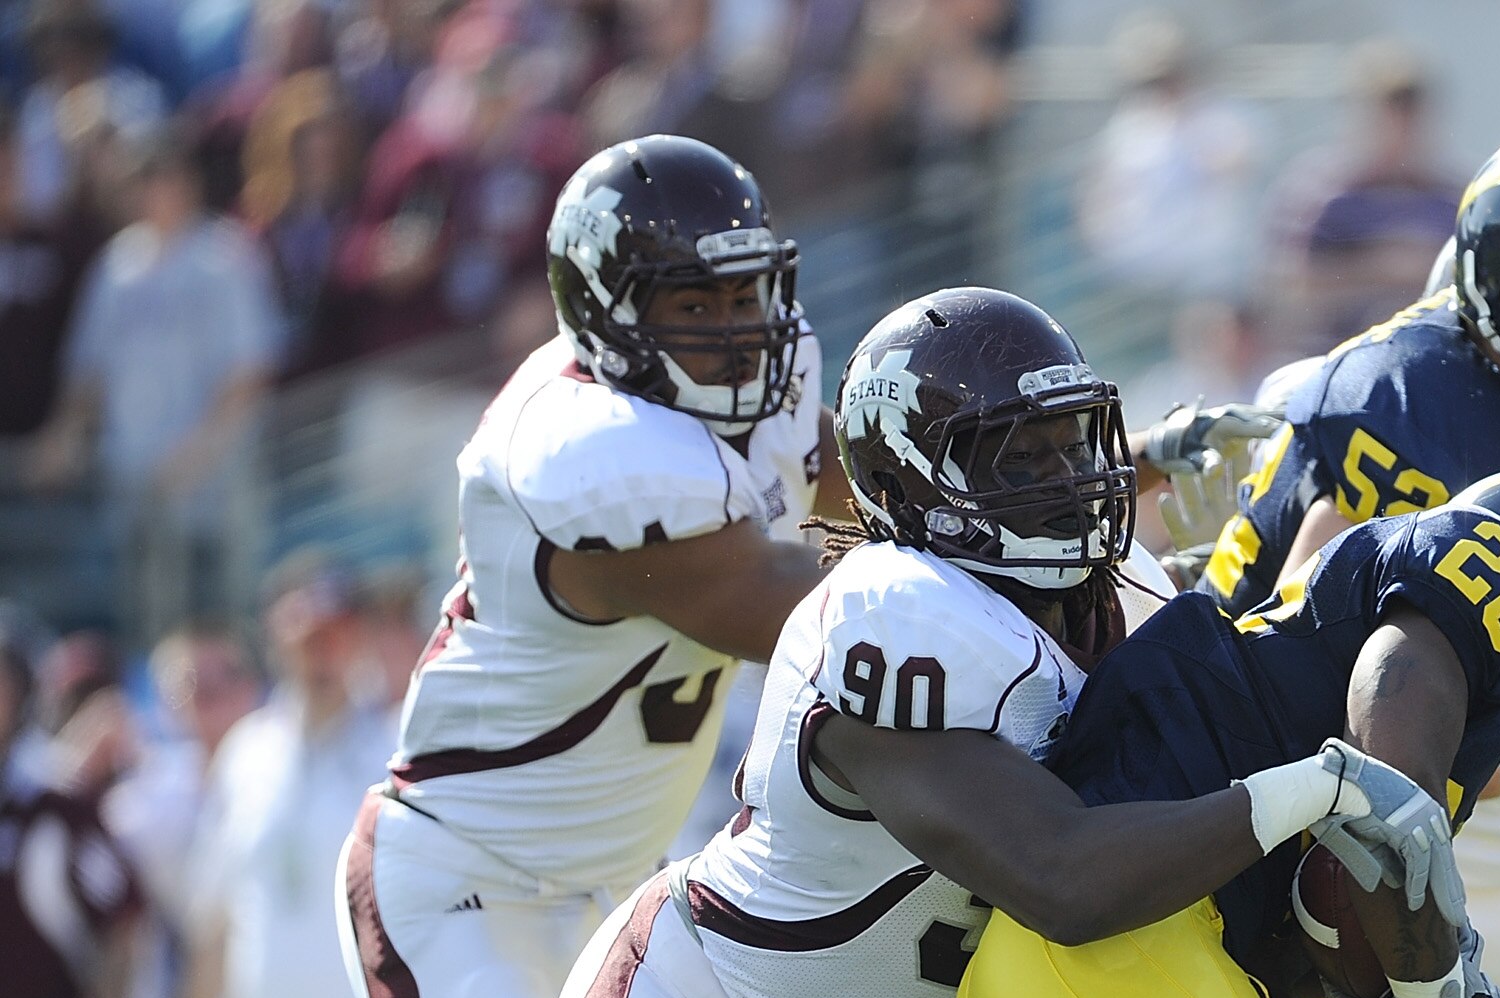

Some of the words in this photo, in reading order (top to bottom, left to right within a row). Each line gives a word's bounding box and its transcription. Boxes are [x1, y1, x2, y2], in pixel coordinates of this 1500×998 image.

[849, 378, 899, 405] STATE
[1336, 427, 1450, 523] 52
[839, 640, 946, 731] 90
